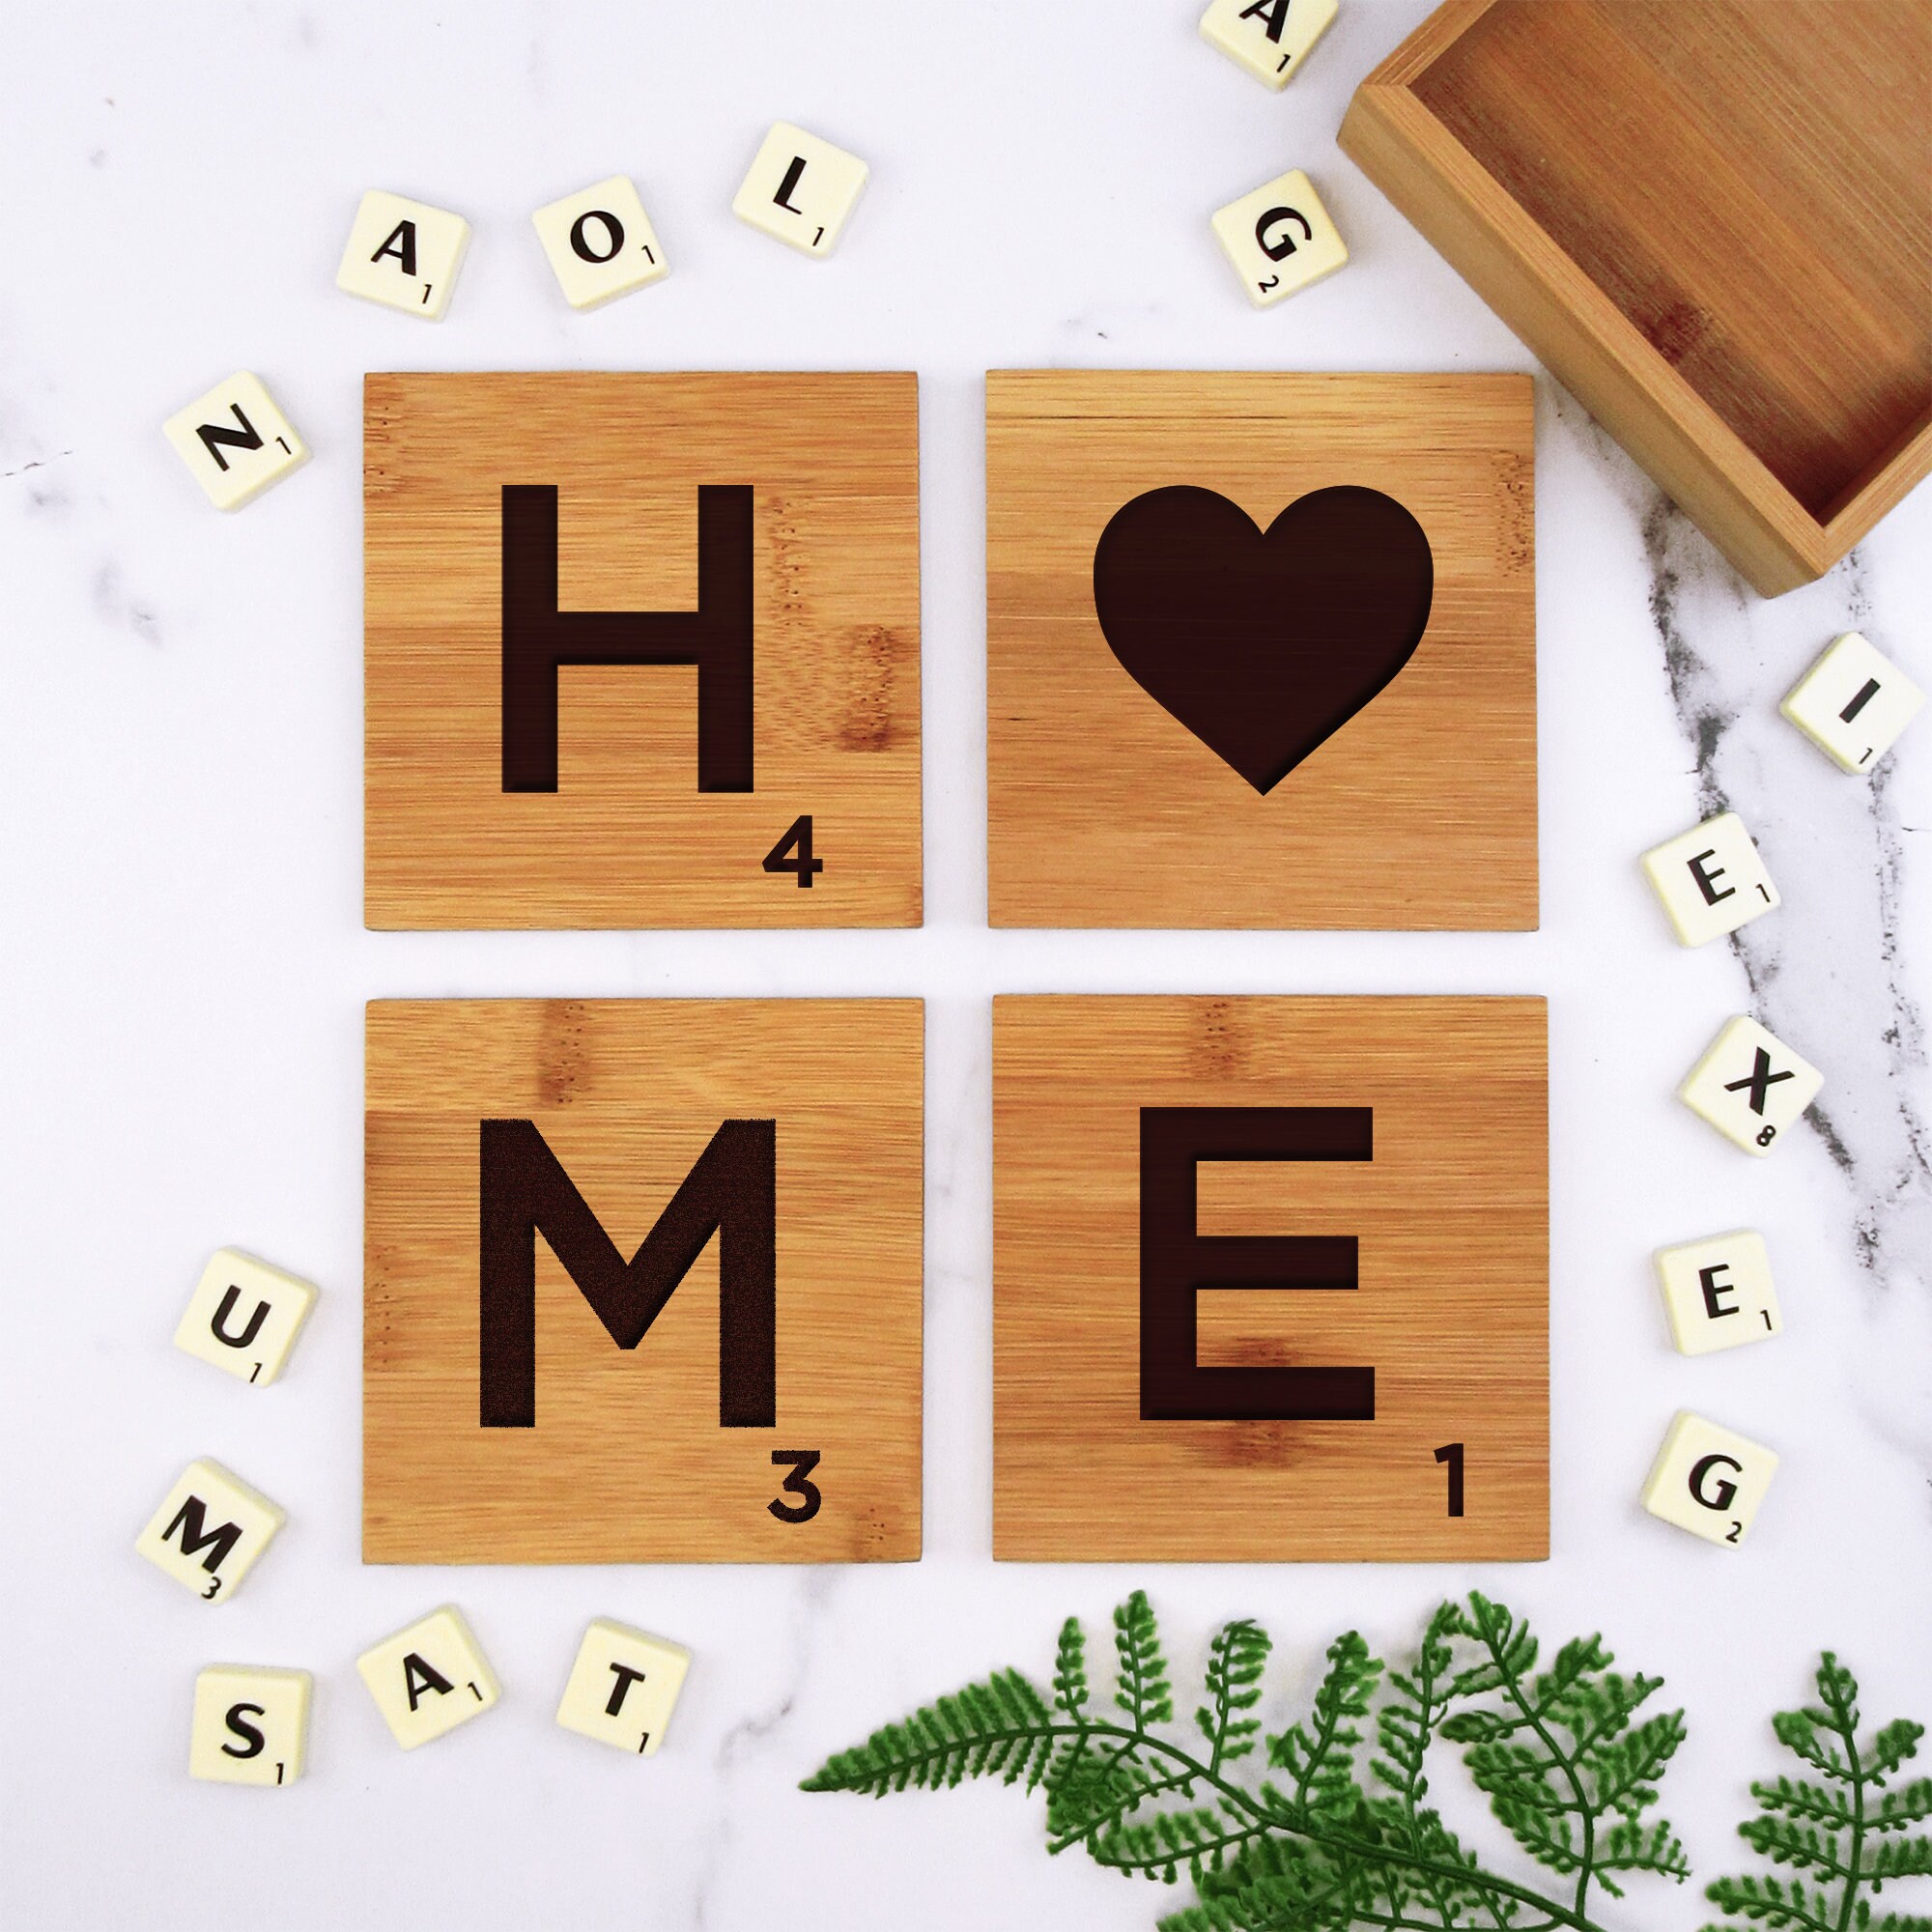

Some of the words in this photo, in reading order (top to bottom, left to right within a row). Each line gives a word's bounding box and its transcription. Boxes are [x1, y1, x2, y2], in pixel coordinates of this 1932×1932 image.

[1239, 0, 1291, 44] A
[1276, 53, 1291, 72] 1
[773, 156, 807, 215] L
[370, 219, 417, 276] A
[570, 210, 625, 264] O
[641, 244, 655, 265] 1
[812, 227, 825, 246] 1
[1255, 206, 1312, 263] G
[422, 284, 432, 304] 1
[1258, 274, 1280, 294] 2
[195, 403, 264, 472] N
[276, 437, 292, 455] 1
[501, 485, 753, 793] H
[1839, 678, 1881, 724] I
[1860, 748, 1873, 764] 1
[762, 815, 823, 888] 4
[1687, 849, 1736, 906] E
[1756, 884, 1771, 902] 1
[1724, 1046, 1795, 1116] X
[1756, 1124, 1776, 1148] 8
[480, 1119, 777, 1428] M
[1140, 1107, 1375, 1421] E
[211, 1285, 271, 1349] U
[1698, 1264, 1740, 1320] E
[1760, 1309, 1773, 1331] 1
[249, 1362, 262, 1383] 1
[767, 1450, 821, 1523] 3
[1434, 1443, 1464, 1517] 1
[1689, 1454, 1743, 1511] G
[161, 1495, 242, 1574] M
[1725, 1520, 1742, 1544] 2
[202, 1577, 222, 1600] 3
[403, 1653, 455, 1712] A
[468, 1682, 483, 1701] 1
[605, 1662, 645, 1717] T
[221, 1703, 265, 1759] S
[639, 1732, 649, 1753] 1
[276, 1762, 284, 1785] 1
